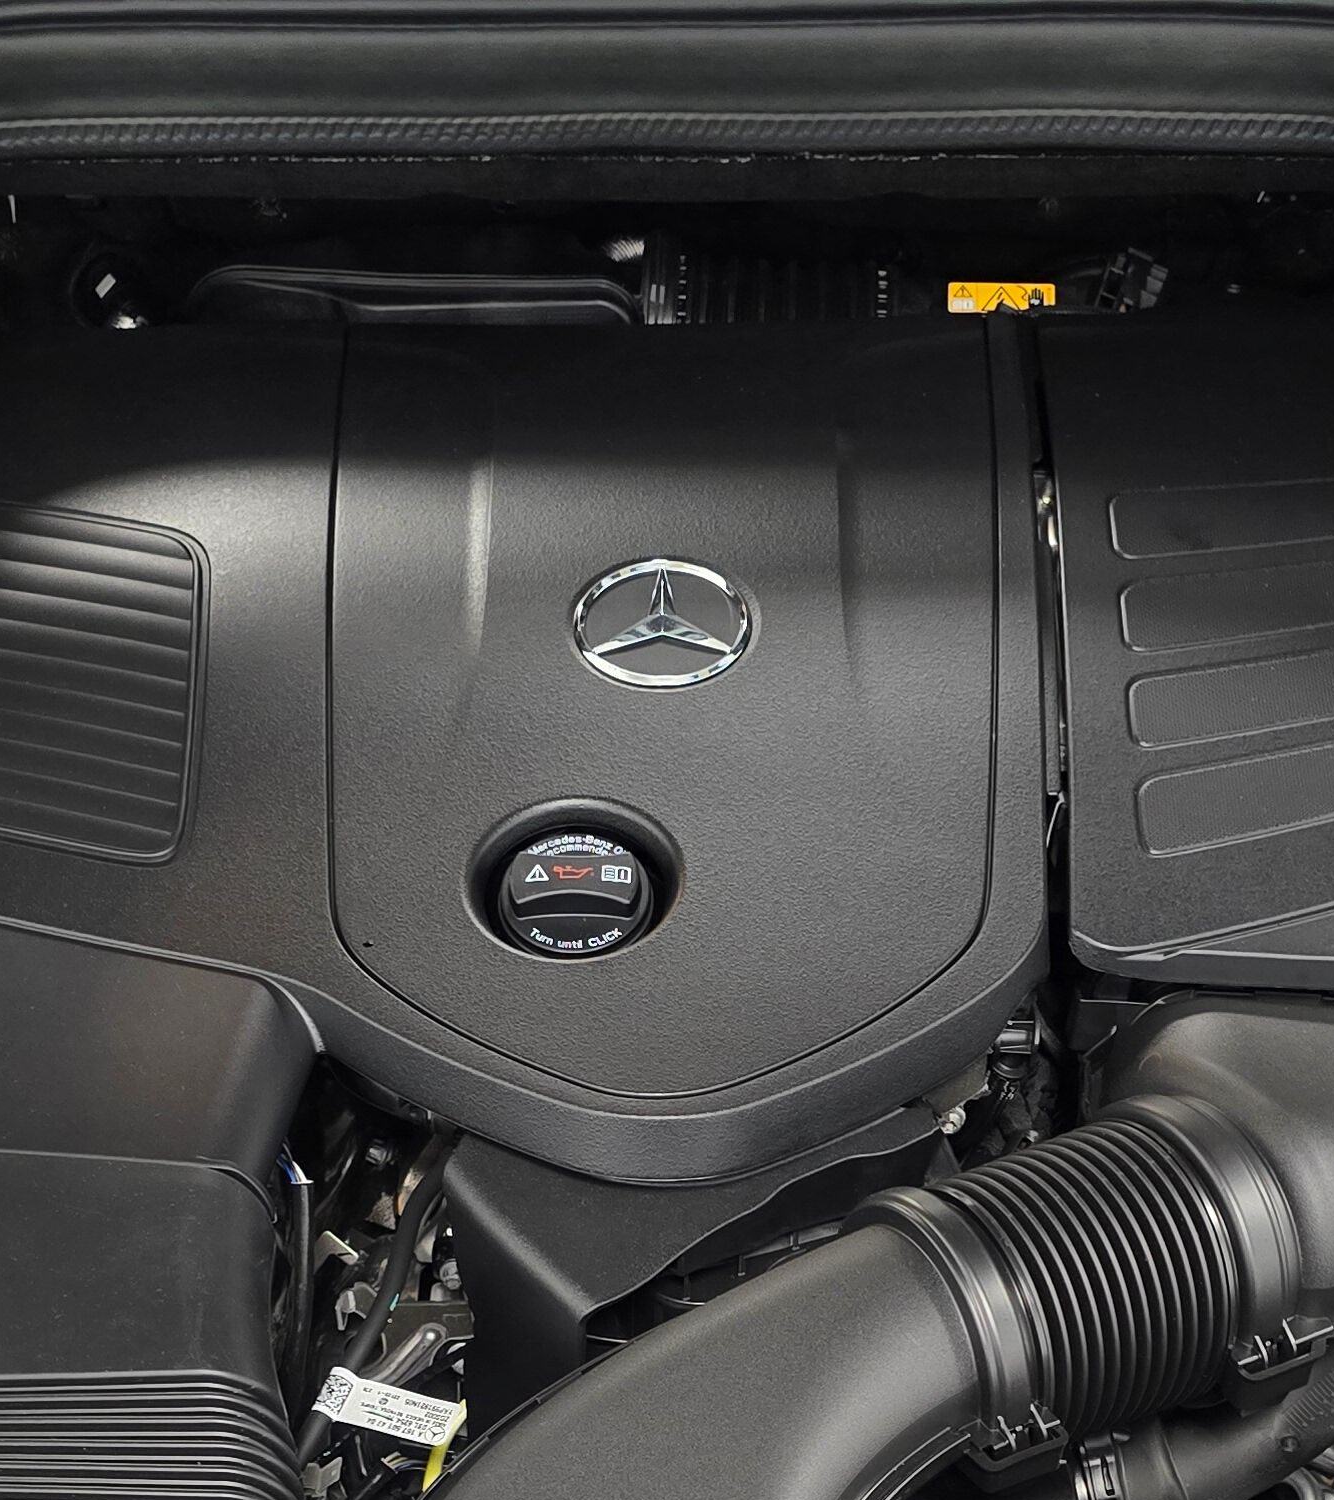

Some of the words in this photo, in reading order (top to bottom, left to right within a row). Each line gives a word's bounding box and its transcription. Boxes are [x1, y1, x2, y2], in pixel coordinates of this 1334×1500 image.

[530, 927, 554, 946] Turn
[557, 940, 583, 949] until
[587, 927, 623, 947] CLICK
